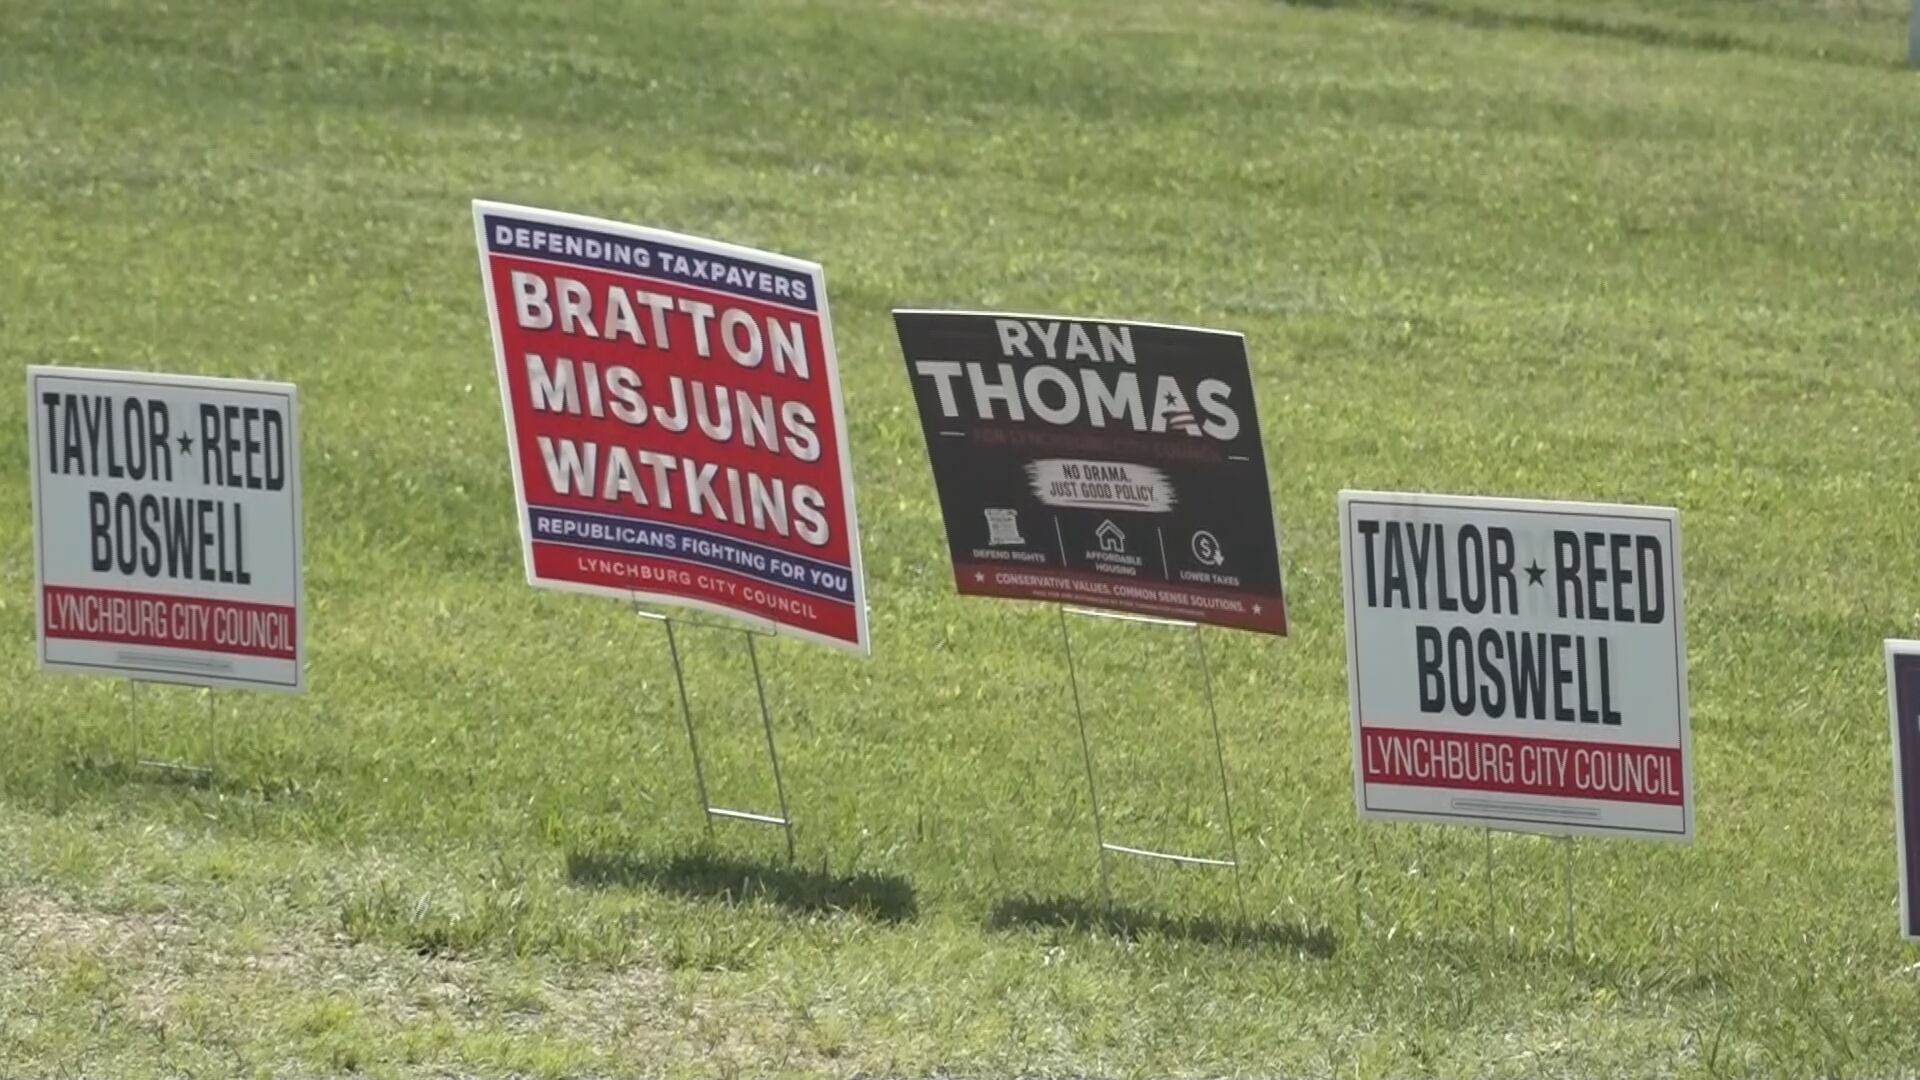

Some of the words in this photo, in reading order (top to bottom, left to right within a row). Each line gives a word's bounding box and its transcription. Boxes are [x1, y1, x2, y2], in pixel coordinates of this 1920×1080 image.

[496, 225, 650, 268] DEFENDING
[657, 252, 807, 300] TAXPAYERS
[510, 270, 811, 381] BRATTON
[995, 319, 1137, 365] RYAN
[524, 353, 822, 464] MISJUNS
[915, 360, 1241, 441] THOMAS
[42, 392, 173, 482] TAYLOR
[199, 402, 285, 492] REED
[1062, 464, 1081, 480] NO
[1083, 465, 1132, 483] DRAMA.
[536, 435, 831, 547] WATKINS
[1050, 481, 1079, 498] JUST
[1080, 483, 1112, 499] GOOD
[89, 491, 251, 585] BOSWELL
[537, 516, 677, 550] REPUBLICANS
[681, 537, 766, 571] FIGHTING
[771, 559, 806, 582] FOR
[810, 569, 848, 593] YOU
[972, 548, 1010, 560] DEFEND
[1011, 551, 1046, 563] RIGHTS
[1085, 551, 1142, 566] AFFORDABLE
[1095, 563, 1137, 577] HOUSING
[578, 556, 691, 586] LYNCHBURG
[697, 575, 737, 596] CITY
[743, 586, 817, 620] COUNCIL
[995, 572, 1071, 590] CONSERVATIVE
[1113, 585, 1157, 600] COMMON
[1158, 590, 1189, 606] SENSE
[1190, 595, 1246, 613] SOLUTIONS.
[1180, 570, 1211, 583] LOWER
[1212, 573, 1240, 587] TAXES
[1358, 519, 1519, 615] TAYLOR
[1554, 529, 1665, 624] REED
[47, 594, 168, 638] LYNCHBURG
[171, 602, 211, 643] CITY
[213, 606, 295, 651] COUNCIL
[1415, 625, 1622, 725] BOSWELL
[1366, 735, 1513, 785] LYNCHBURG
[1519, 744, 1569, 788] CITY
[1574, 748, 1680, 797] COUNCIL
